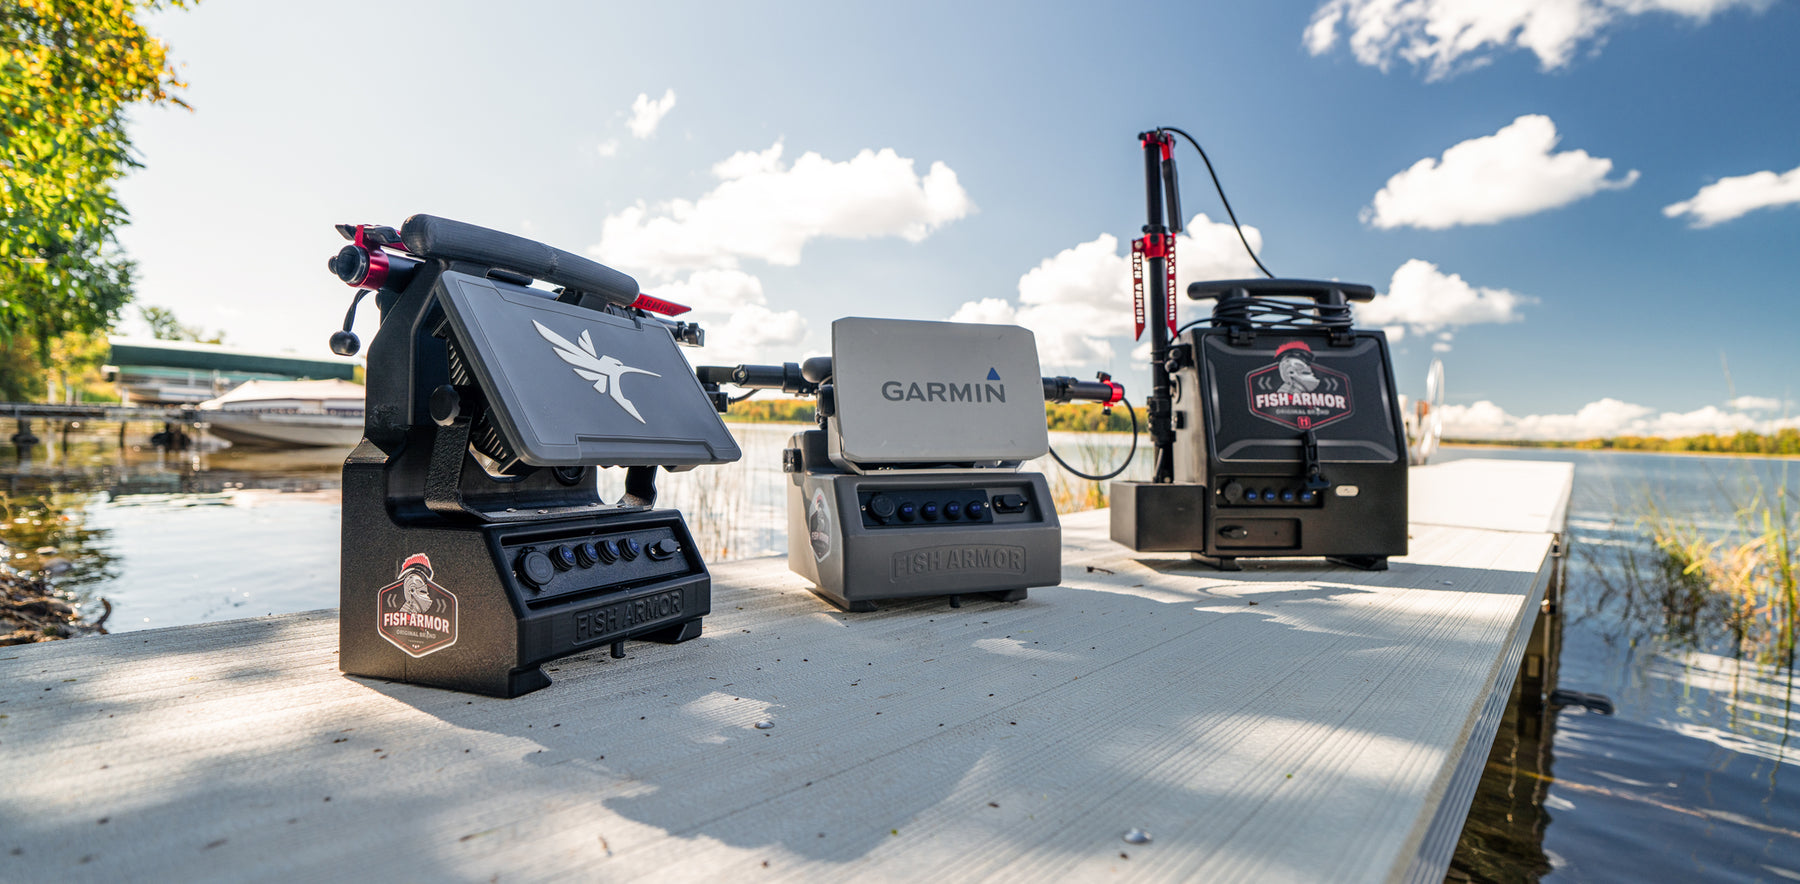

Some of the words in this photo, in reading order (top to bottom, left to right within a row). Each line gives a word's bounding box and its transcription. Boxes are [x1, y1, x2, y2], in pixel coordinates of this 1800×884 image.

[881, 381, 1006, 403] GARMIN
[1256, 393, 1289, 408] FISH
[1292, 392, 1346, 409] ARMOR
[895, 551, 940, 577] FISH
[946, 549, 1021, 570] ARMOR
[383, 612, 408, 627] FISH
[409, 612, 450, 634] ARMOR
[576, 606, 618, 640] FISH
[622, 592, 680, 628] ARMOR
